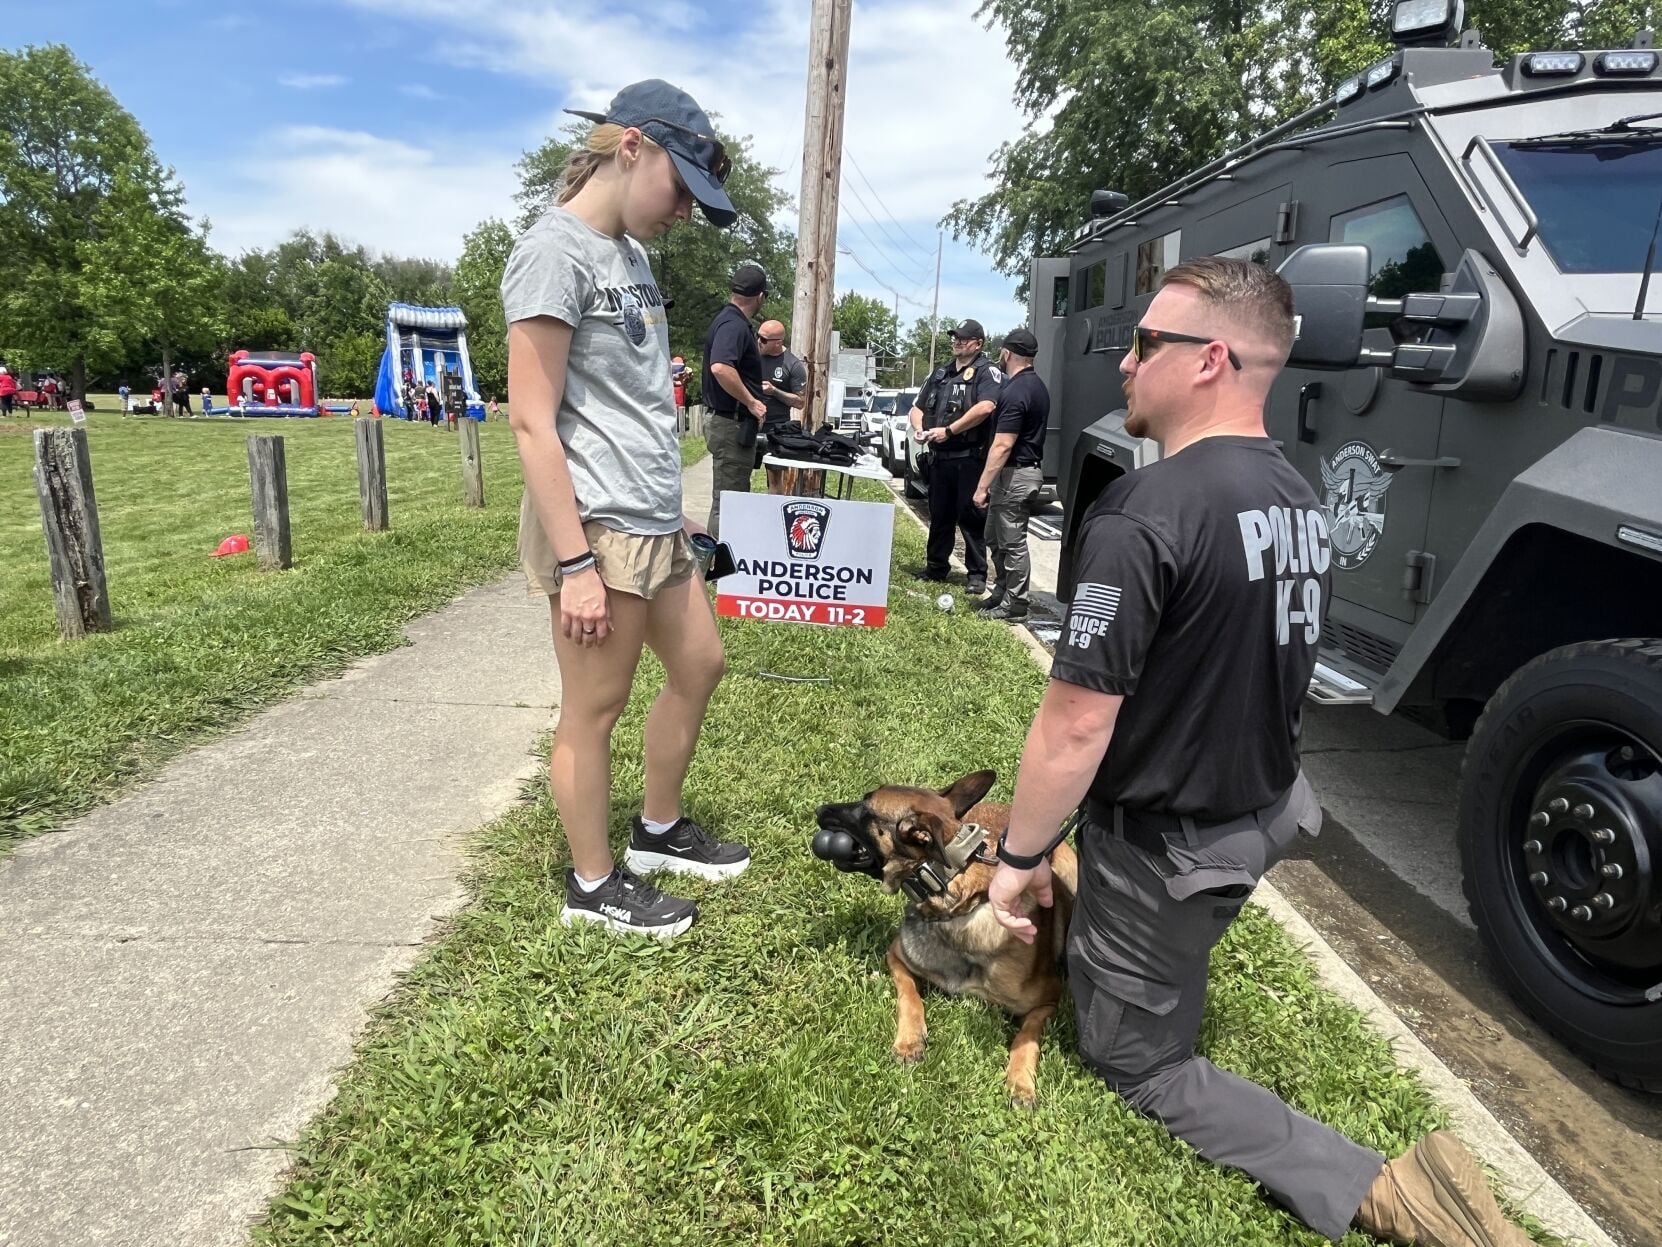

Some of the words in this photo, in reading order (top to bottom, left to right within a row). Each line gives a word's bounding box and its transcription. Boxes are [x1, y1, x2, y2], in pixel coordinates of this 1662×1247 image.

[1331, 445, 1365, 470] ANDERSON
[1364, 450, 1382, 474] SWAT
[1237, 505, 1332, 582] POLIC
[736, 558, 873, 585] ANDERSON
[758, 578, 847, 601] POLICE
[736, 599, 817, 621] TODAY
[827, 606, 865, 625] 11-2
[1276, 578, 1321, 646] K-9
[1070, 615, 1109, 637] OLICE
[1068, 630, 1091, 649] K-9
[599, 902, 632, 923] HOKA
